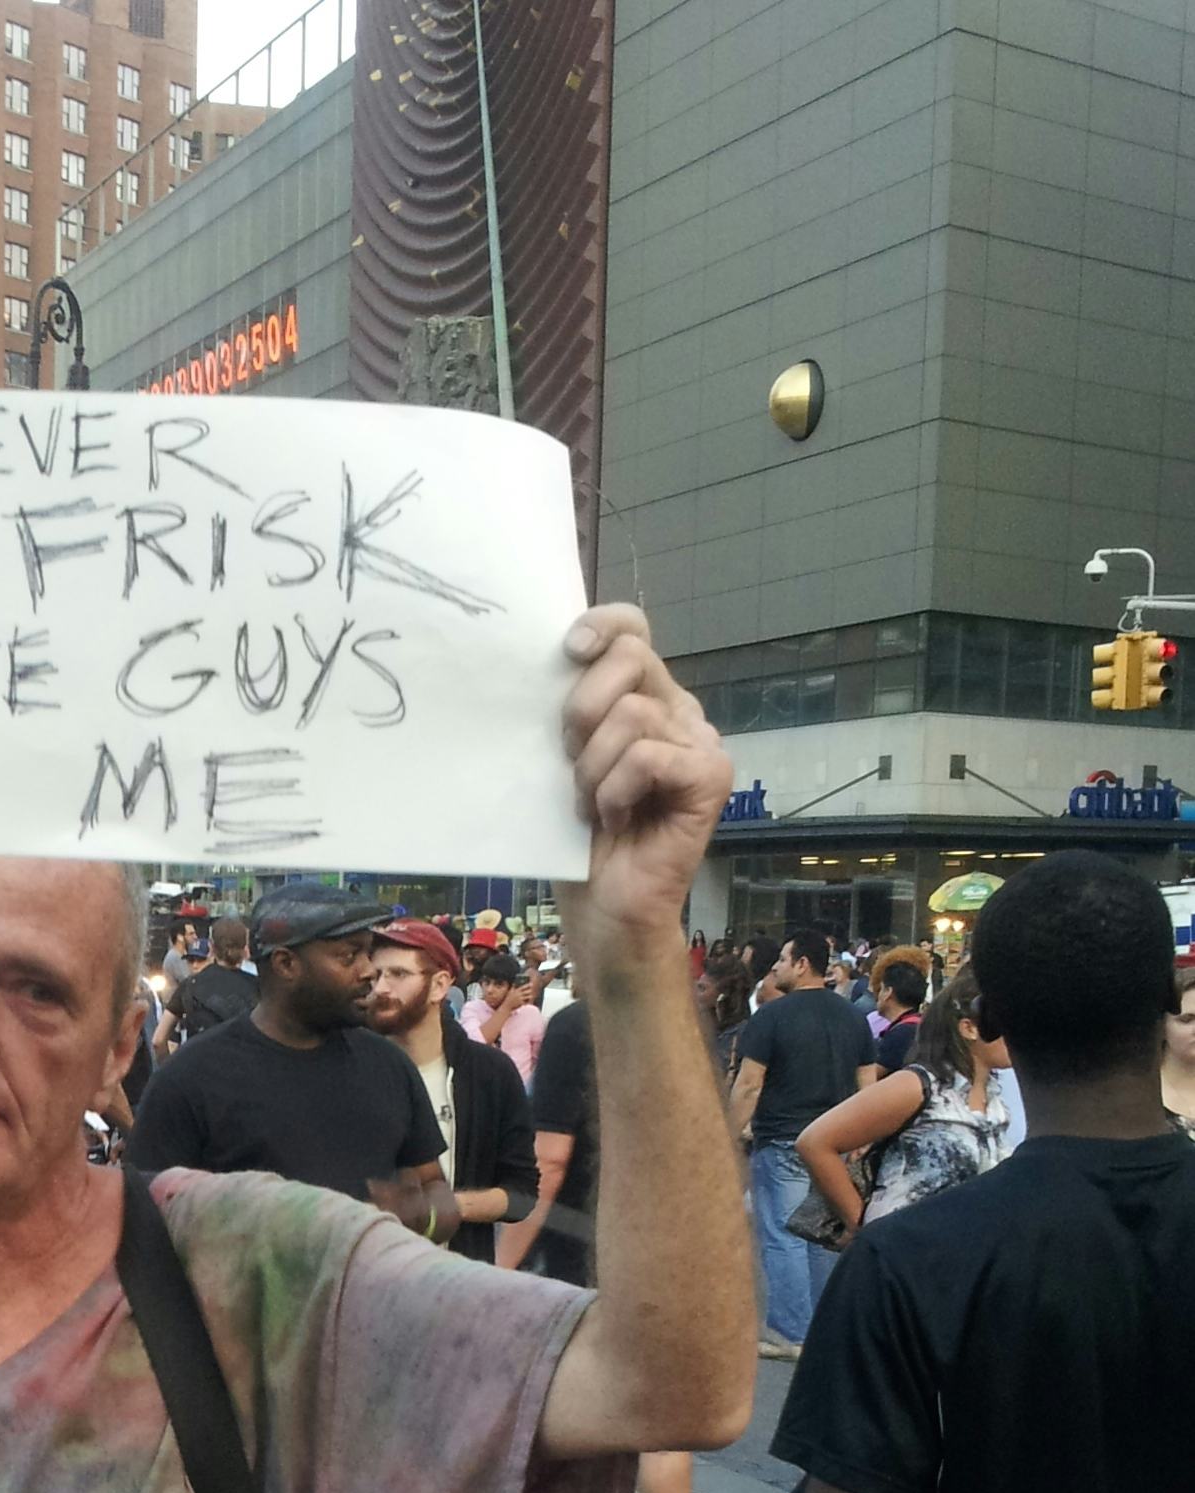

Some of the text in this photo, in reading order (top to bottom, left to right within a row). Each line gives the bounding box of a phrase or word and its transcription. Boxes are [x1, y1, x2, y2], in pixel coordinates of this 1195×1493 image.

[4, 461, 511, 616] FRISK
[115, 613, 408, 729] GUYS
[78, 738, 325, 858] ME
